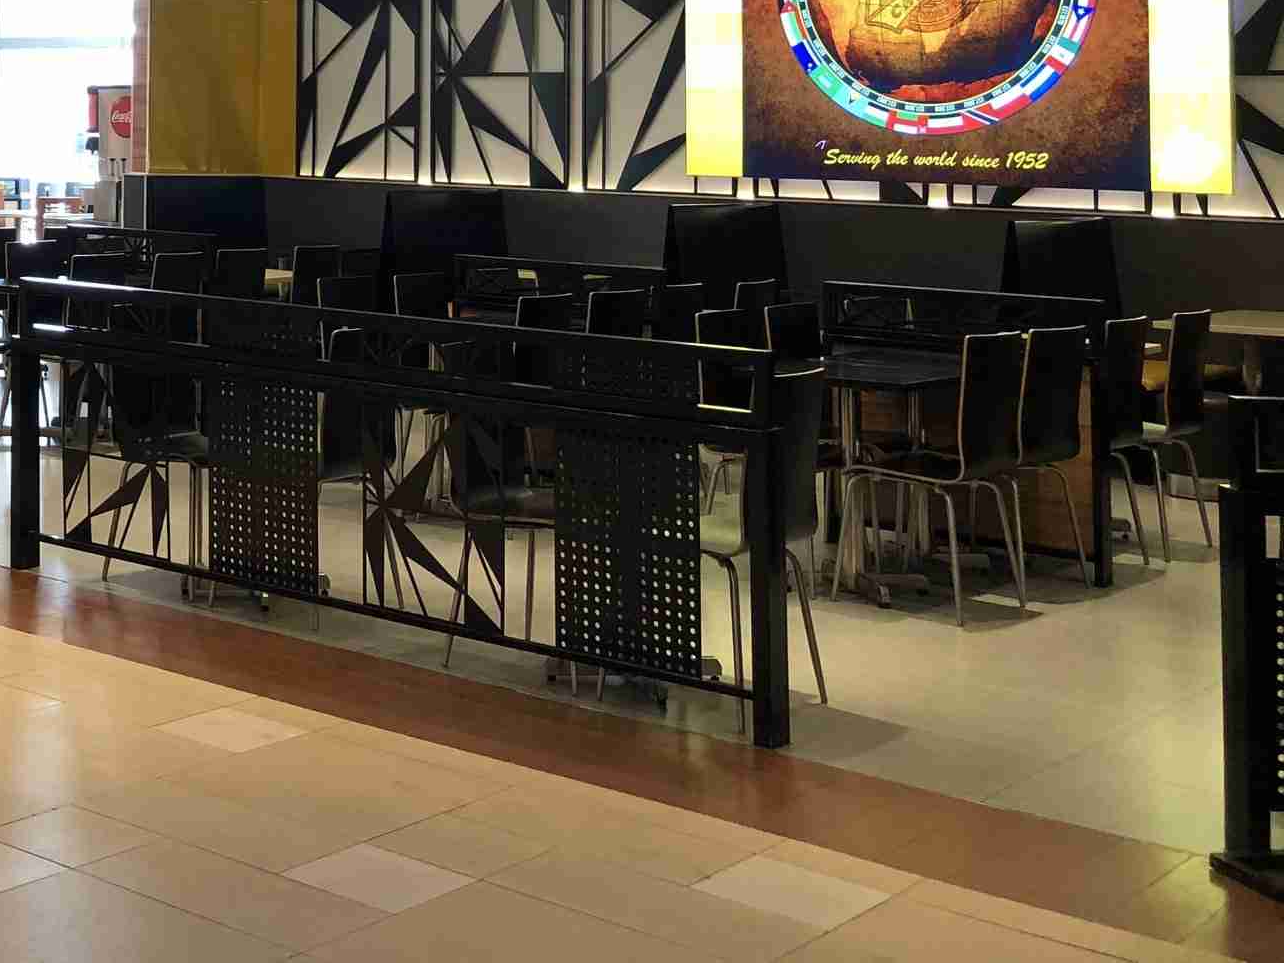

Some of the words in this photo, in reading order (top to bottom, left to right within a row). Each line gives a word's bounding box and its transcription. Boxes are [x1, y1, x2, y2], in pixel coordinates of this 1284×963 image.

[824, 149, 882, 170] Serving
[885, 149, 908, 167] the
[914, 151, 957, 167] world
[962, 154, 1000, 169] since
[1005, 151, 1050, 169] 1952
